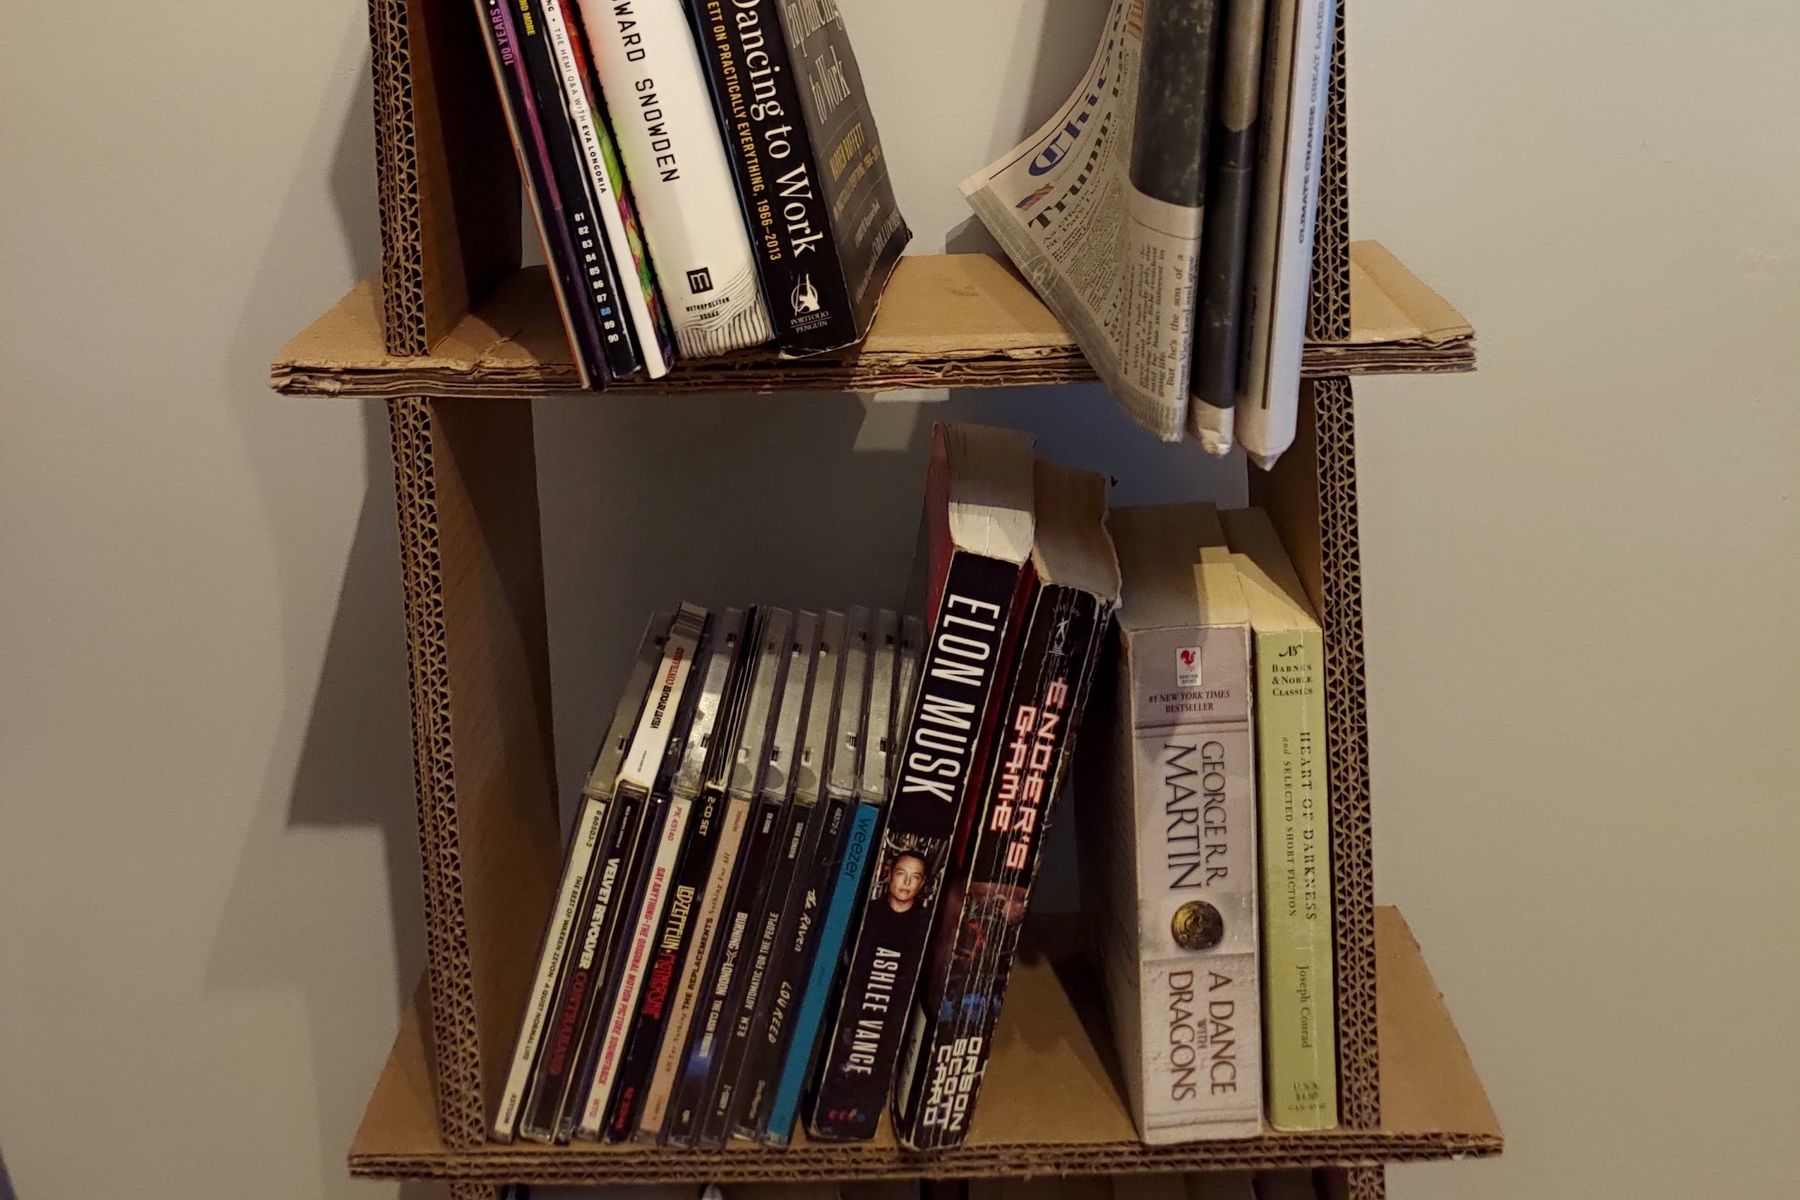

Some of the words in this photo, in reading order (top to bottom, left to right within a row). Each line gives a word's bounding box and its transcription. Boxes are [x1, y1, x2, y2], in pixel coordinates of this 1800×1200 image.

[490, 7, 508, 44] YEARS
[522, 11, 535, 36] MORE
[712, 23, 727, 42] ON
[500, 45, 514, 65] 100
[717, 43, 747, 119] PRACTICALLY
[553, 27, 564, 46] THE
[559, 48, 572, 72] HEMI
[581, 123, 593, 142] EVA
[588, 144, 608, 193] LONGORIA
[634, 76, 680, 183] SNOWDEN
[764, 122, 800, 160] to
[1304, 106, 1316, 171] CHANGE
[737, 120, 766, 195] EVERYTHING,
[574, 212, 585, 222] 81
[776, 162, 824, 258] Work
[578, 226, 590, 235] 82
[582, 239, 593, 249] 83
[585, 253, 597, 262] 84
[596, 293, 607, 303] 87
[604, 320, 615, 330] 89
[790, 310, 830, 326] PORTFOLIO
[795, 320, 829, 334] PENGUIN
[607, 334, 619, 343] 90
[931, 594, 1000, 687] ELON
[1160, 692, 1179, 702] NEW
[1180, 691, 1204, 701] YORK
[1206, 689, 1231, 699] TIMES
[1165, 702, 1214, 714] BESTSELLER
[902, 694, 976, 803] MUSK
[990, 705, 1037, 832] GAME
[1005, 676, 1068, 869] ENDER'S
[702, 796, 714, 818] 2-CD
[1202, 740, 1227, 838] GEORGE
[1283, 760, 1293, 823] SELECTED
[697, 818, 708, 835] SET
[1164, 743, 1202, 889] MARTIN
[844, 816, 870, 880] weezer
[1285, 826, 1295, 867] SHORT
[572, 874, 582, 889] THE
[597, 856, 619, 904] VELVET
[654, 866, 665, 881] SAY
[567, 890, 578, 907] BEST
[1287, 868, 1297, 918] FICTION
[554, 918, 569, 950] WARREN
[578, 903, 606, 971] REVOLVER
[727, 910, 748, 951] BURNING
[764, 910, 778, 939] PEOPLE
[546, 951, 559, 977] ZEVON
[629, 938, 645, 973] ORIGINAL
[681, 991, 692, 1011] THE
[687, 916, 713, 990] REPLACEMENTS
[755, 954, 766, 969] FOR
[760, 939, 770, 953] THE
[620, 974, 635, 1003] MOTION
[714, 960, 733, 996] LONDON
[744, 969, 762, 1009] AUTOMATIC
[776, 980, 792, 1008] LOU
[862, 946, 901, 1013] ASHLEE
[1208, 971, 1233, 992] A
[1295, 964, 1310, 1003] Joseph
[536, 989, 548, 1011] QUIET
[612, 1003, 627, 1034] PICTURE
[526, 1012, 541, 1044] NORMAL
[765, 1007, 784, 1044] REED
[1168, 970, 1197, 1101] DRAGONS
[597, 1035, 618, 1085] SOUNDTRACK
[849, 1020, 884, 1076] VANCE
[1209, 1000, 1237, 1095] DANCE
[923, 1045, 952, 1126] CARD
[937, 1038, 968, 1130] SCOTT
[949, 1036, 983, 1131] ORSON
